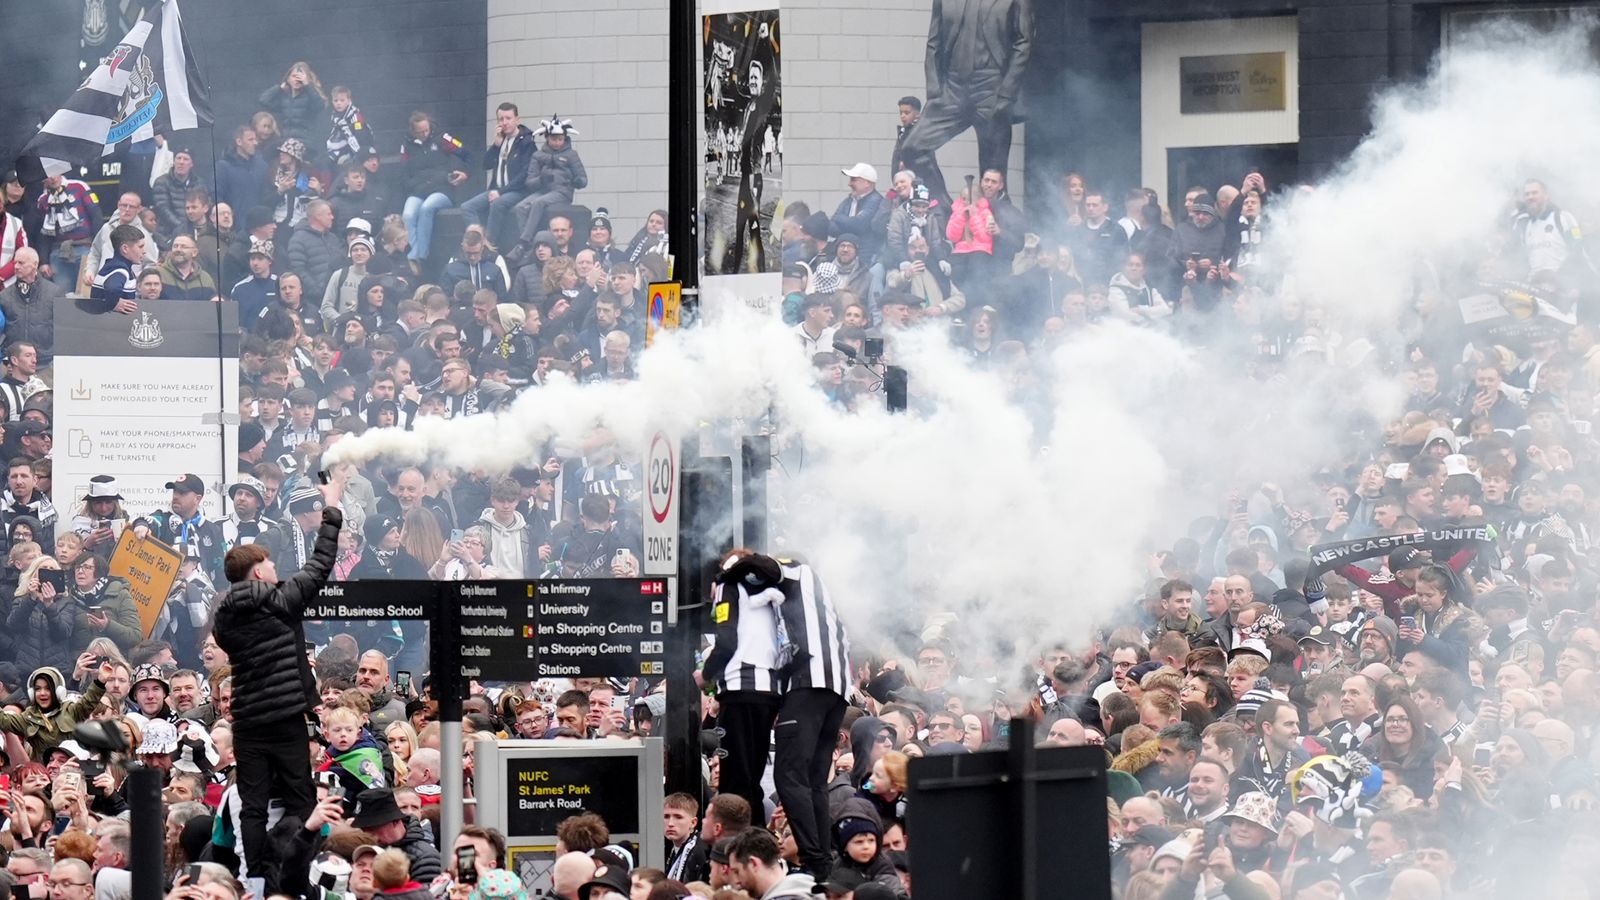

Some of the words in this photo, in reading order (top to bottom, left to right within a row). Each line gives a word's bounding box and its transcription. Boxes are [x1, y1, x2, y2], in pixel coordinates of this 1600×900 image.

[652, 458, 670, 495] 20
[648, 537, 672, 562] ZONE
[1312, 532, 1425, 566] NEWCASTLE
[156, 556, 172, 575] Park
[474, 585, 497, 596] Monument
[551, 584, 590, 596] Infirmary
[653, 583, 662, 593] H
[130, 588, 152, 607] closed
[319, 606, 336, 617] Uni
[338, 605, 384, 617] Business
[387, 605, 423, 616] School
[540, 603, 590, 617] University
[499, 625, 514, 636] Station
[556, 622, 606, 636] Shopping
[608, 622, 643, 633] Centre
[475, 645, 491, 656] Station
[551, 643, 597, 656] Shopping
[599, 643, 632, 653] Centre
[538, 663, 581, 675] Stations
[519, 771, 549, 782] NUFC
[519, 786, 530, 796] St
[532, 785, 566, 795] James'
[568, 785, 590, 794] Park
[557, 798, 582, 808] Road
